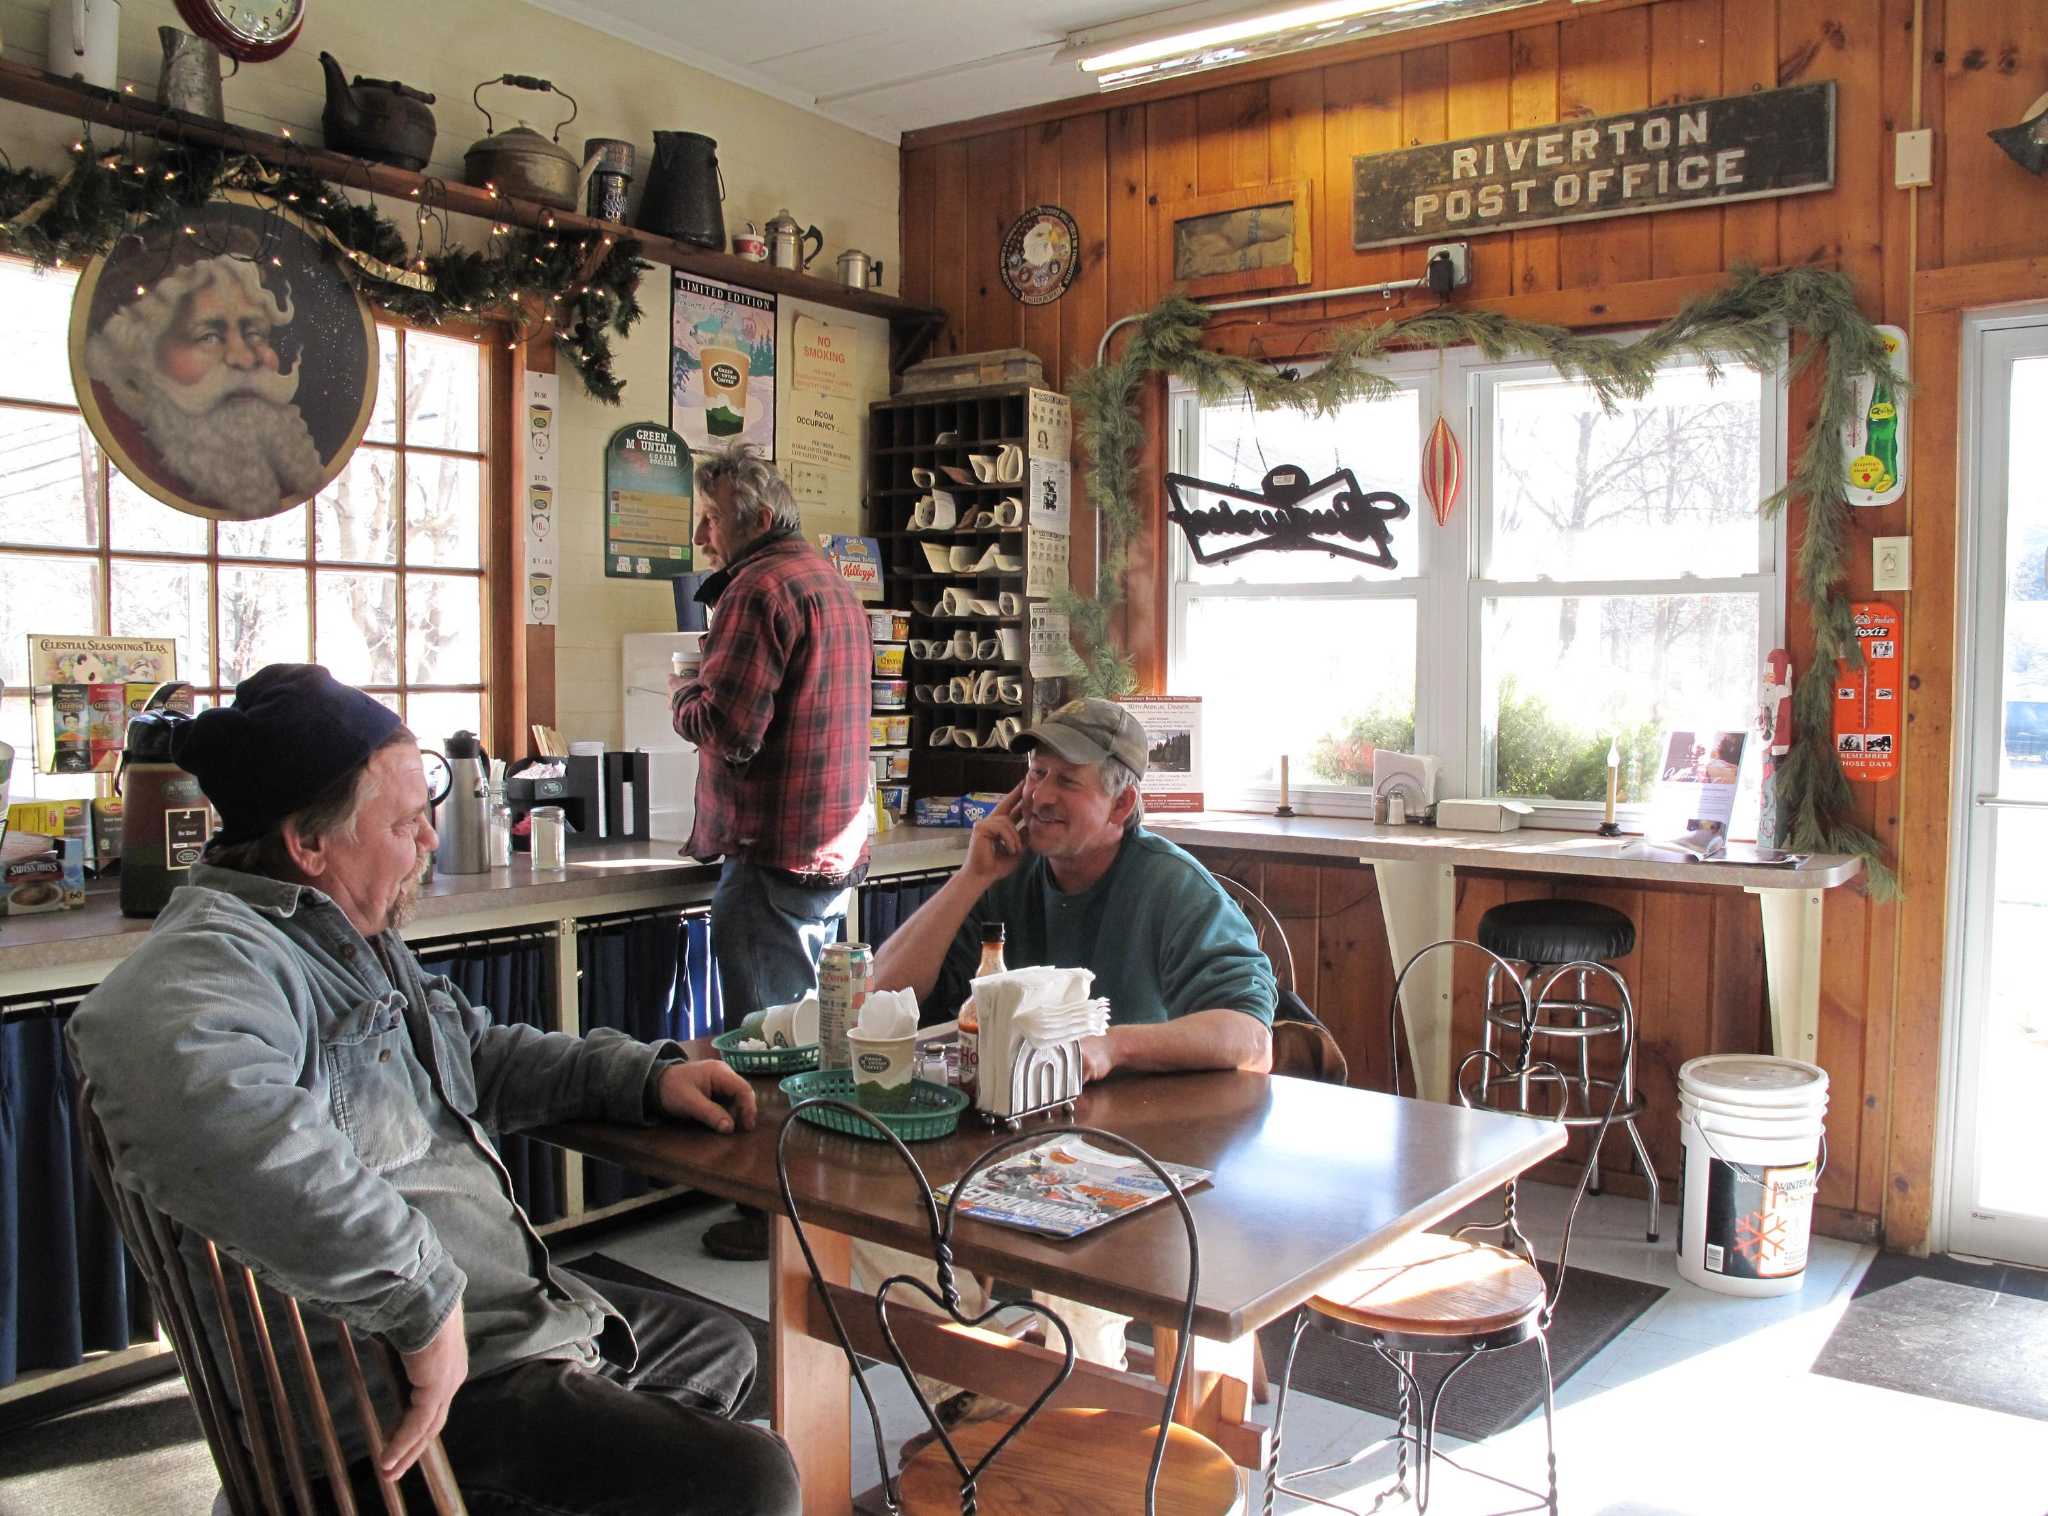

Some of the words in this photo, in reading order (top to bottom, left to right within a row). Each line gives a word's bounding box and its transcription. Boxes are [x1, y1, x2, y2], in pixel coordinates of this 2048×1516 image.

[276, 7, 283, 20] 4
[262, 15, 271, 30] 5
[1451, 111, 1708, 180] RIVERTON
[1413, 180, 1537, 227] POST
[1553, 149, 1745, 207] OFFICE
[680, 279, 724, 299] LIMITED
[727, 291, 770, 310] EDITION
[817, 335, 831, 347] NO
[803, 346, 846, 364] SMOKING
[814, 409, 834, 421] ROOM
[796, 415, 836, 432] OCCUPANCY
[636, 430, 668, 443] GREEN
[843, 563, 876, 581] Kellogg's
[40, 638, 87, 652] CELESTIAL
[87, 639, 144, 652] SEASONINGS
[9, 860, 35, 876] SWISS
